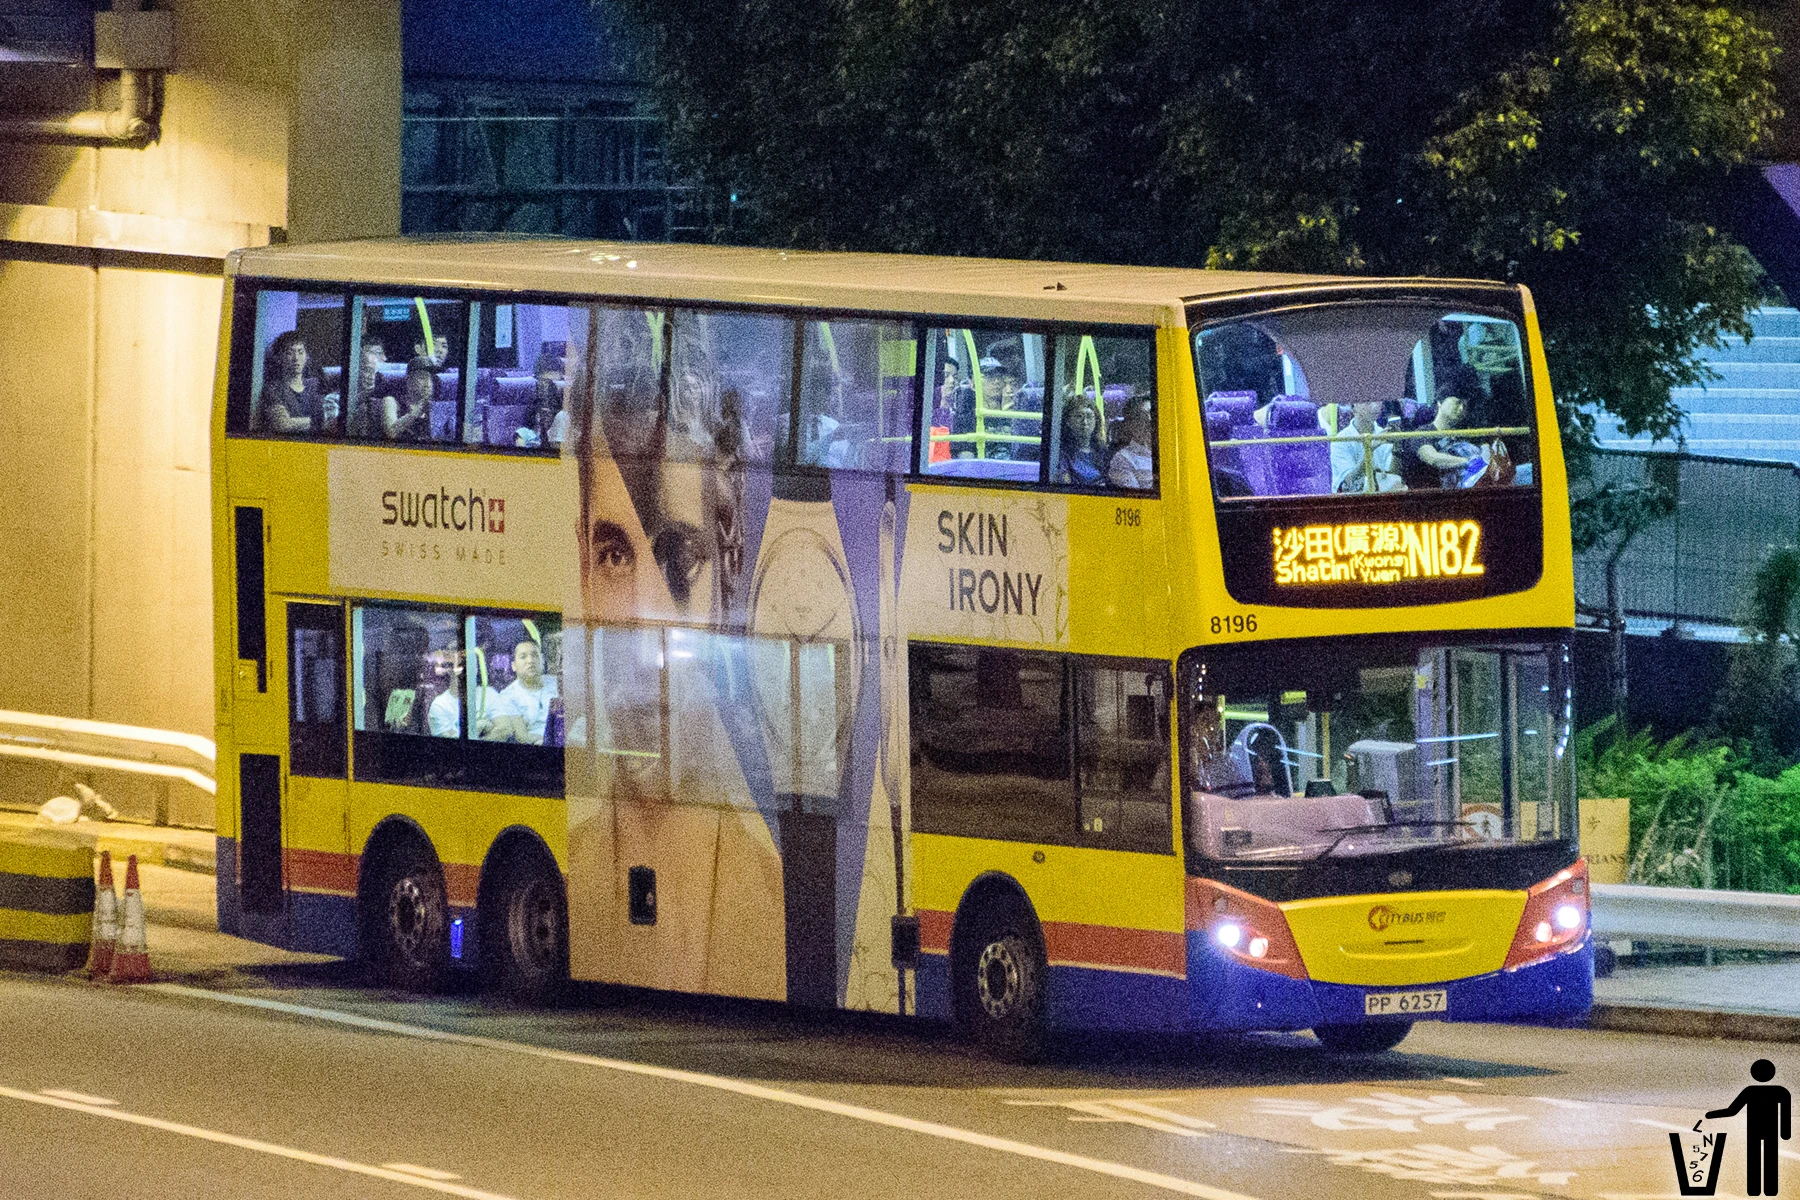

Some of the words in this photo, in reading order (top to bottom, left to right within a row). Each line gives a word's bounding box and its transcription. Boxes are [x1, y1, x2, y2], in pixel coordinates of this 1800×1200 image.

[382, 486, 486, 533] swatch
[1115, 507, 1141, 527] 8196
[937, 510, 1008, 557] SKIN
[1408, 520, 1485, 577] N182
[382, 540, 441, 561] SWISS
[456, 545, 506, 565] MADE
[949, 568, 1043, 616] IRONY
[1210, 614, 1258, 635] 8196
[1368, 997, 1391, 1012] PP
[1399, 993, 1443, 1011] 6257
